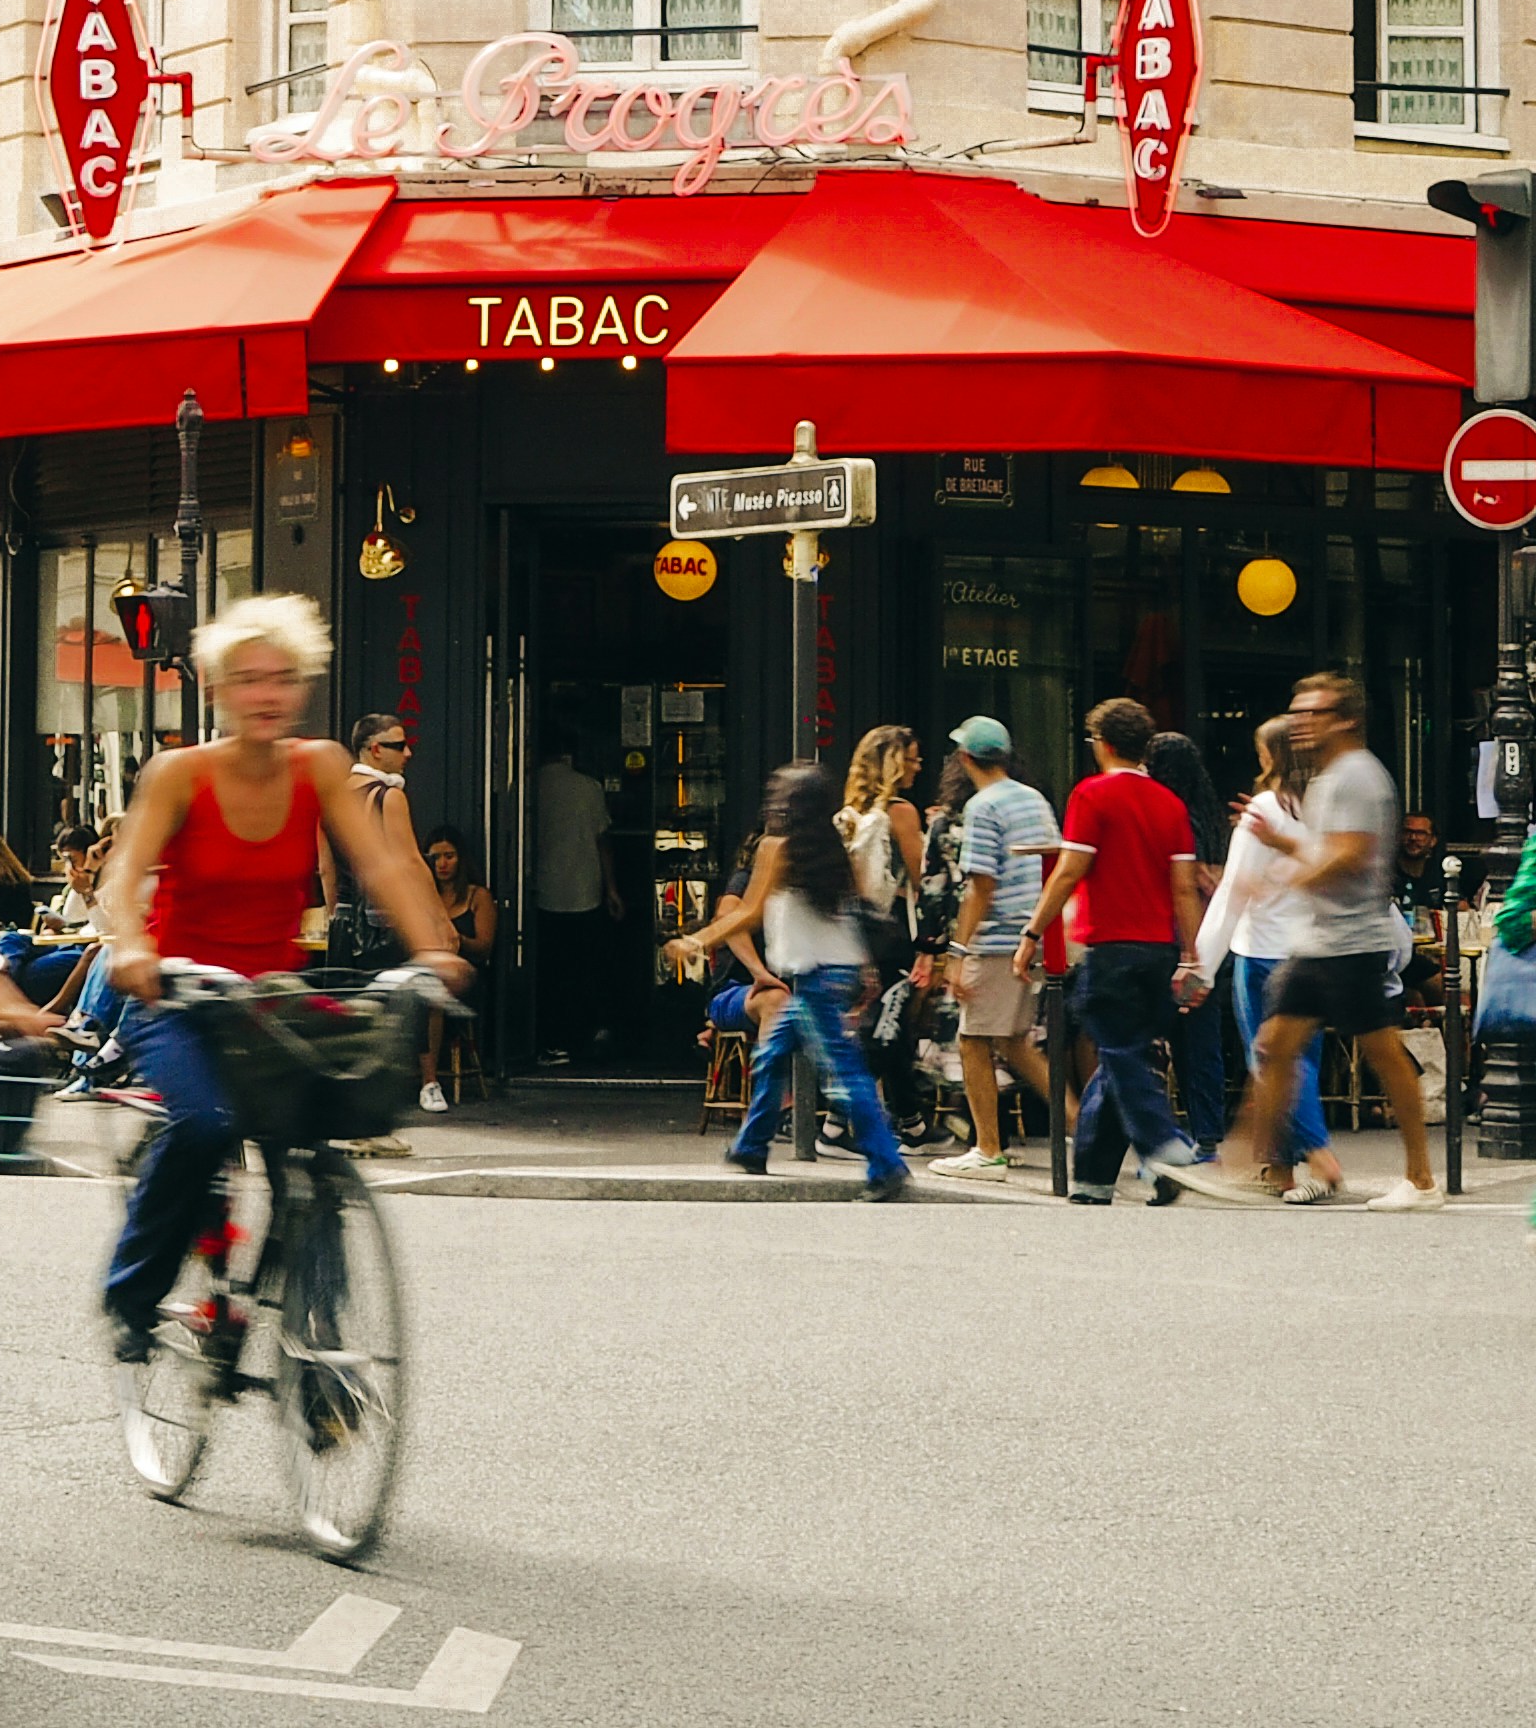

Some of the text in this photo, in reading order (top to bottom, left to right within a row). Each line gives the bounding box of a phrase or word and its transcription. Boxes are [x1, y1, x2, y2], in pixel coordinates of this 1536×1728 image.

[249, 30, 917, 197] Le Progrès
[467, 294, 670, 347] TABAC
[963, 457, 987, 473] RUE
[945, 477, 1005, 494] DE BRETAGNE
[733, 491, 773, 513] Musée
[775, 487, 824, 509] Picasso
